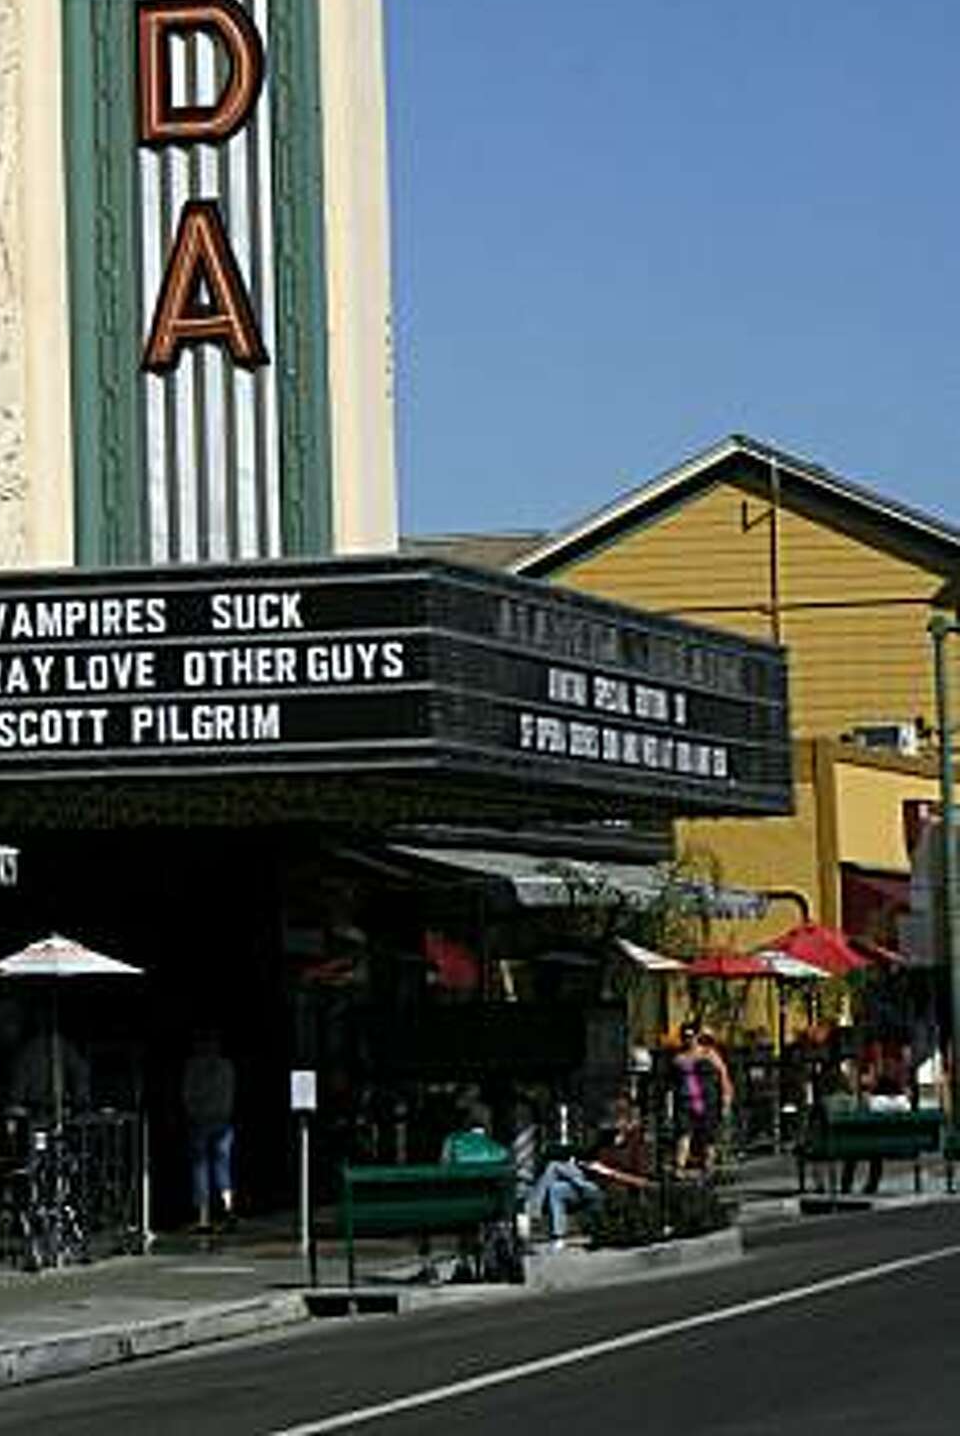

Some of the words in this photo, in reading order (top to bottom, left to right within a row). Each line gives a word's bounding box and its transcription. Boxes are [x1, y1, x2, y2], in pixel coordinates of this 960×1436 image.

[211, 592, 304, 629] SUCK
[65, 651, 156, 691] LOVE
[183, 647, 297, 687] OTHER
[306, 641, 404, 682] GUYS
[131, 703, 280, 743] PILGRIM
